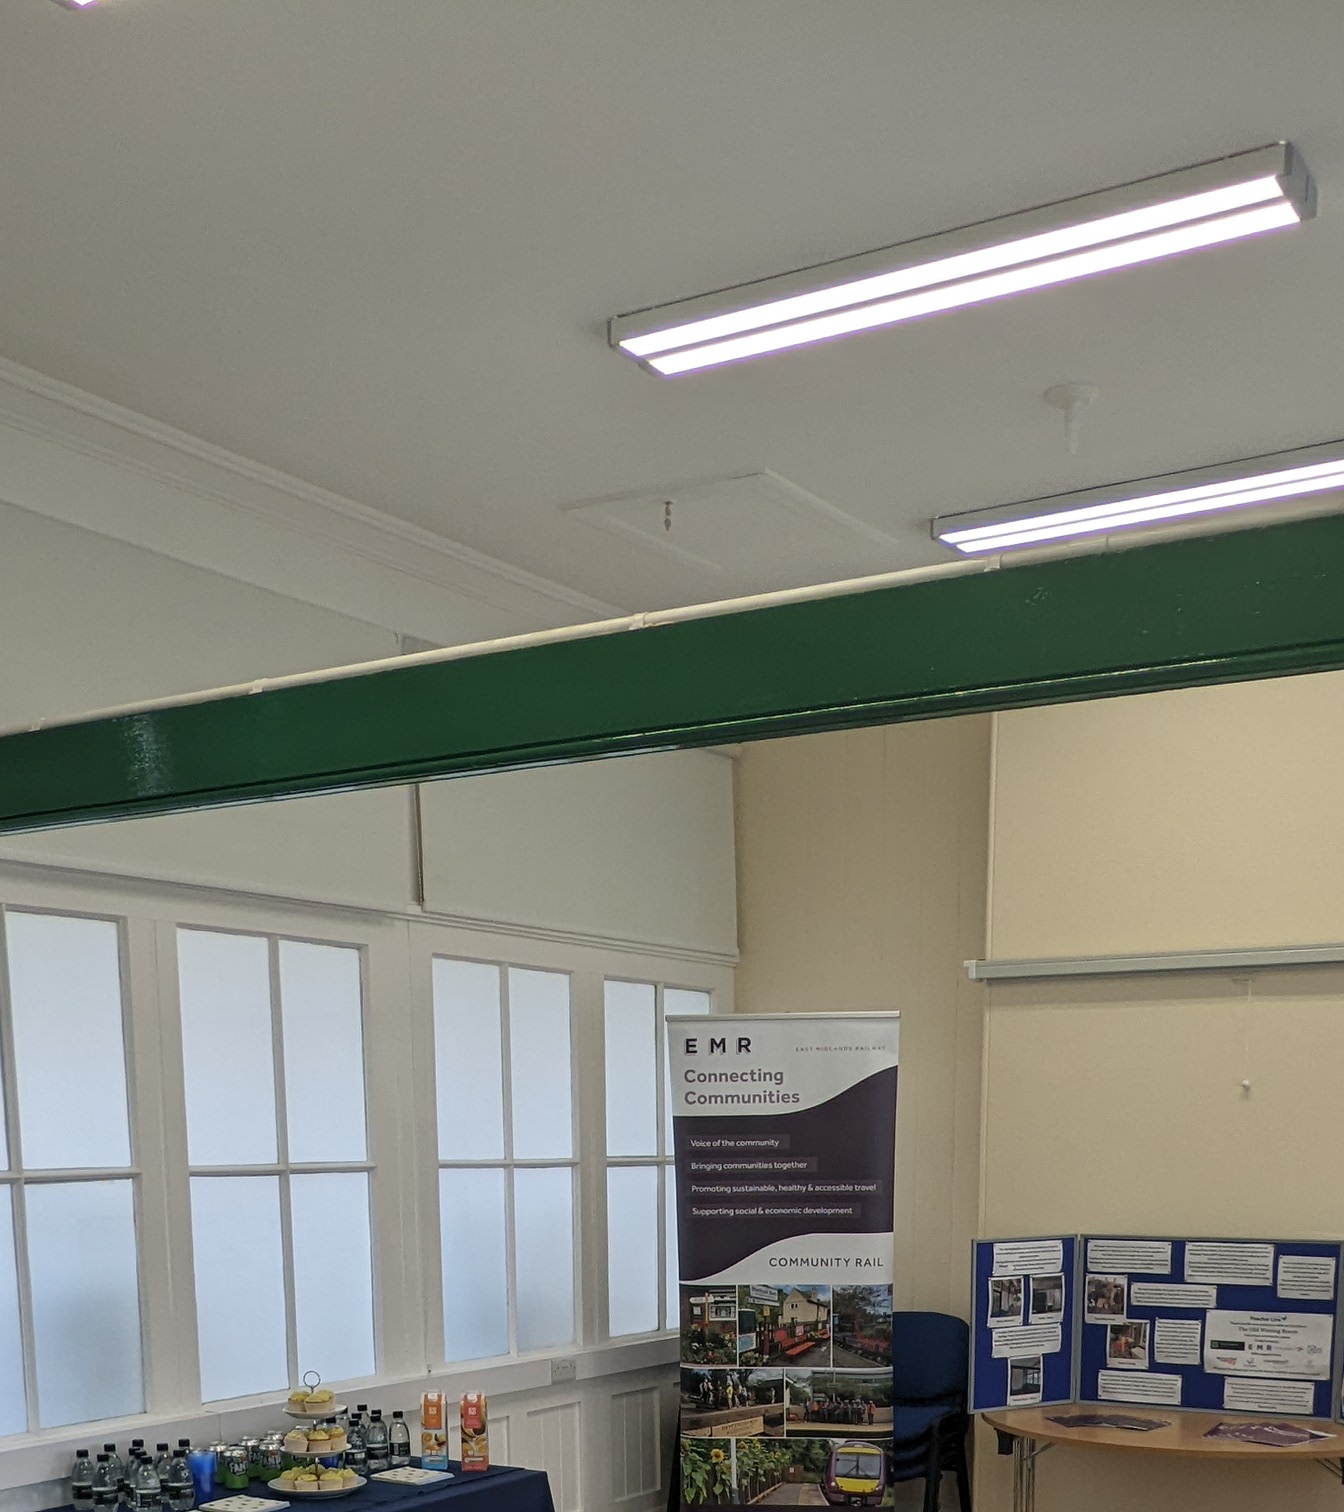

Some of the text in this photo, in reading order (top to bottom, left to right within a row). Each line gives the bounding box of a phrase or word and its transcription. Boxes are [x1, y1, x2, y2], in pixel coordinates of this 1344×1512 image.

[684, 1068, 784, 1085] Connecting
[684, 1090, 800, 1105] Communities
[690, 1139, 779, 1148] Voice of the community
[691, 1161, 807, 1171] Bringing communities together
[691, 1183, 876, 1194] Promoting sustainable, healthy & accessible travel
[692, 1207, 853, 1217] Supporting social & economic development
[769, 1257, 884, 1268] COMMUNITY RAIL
